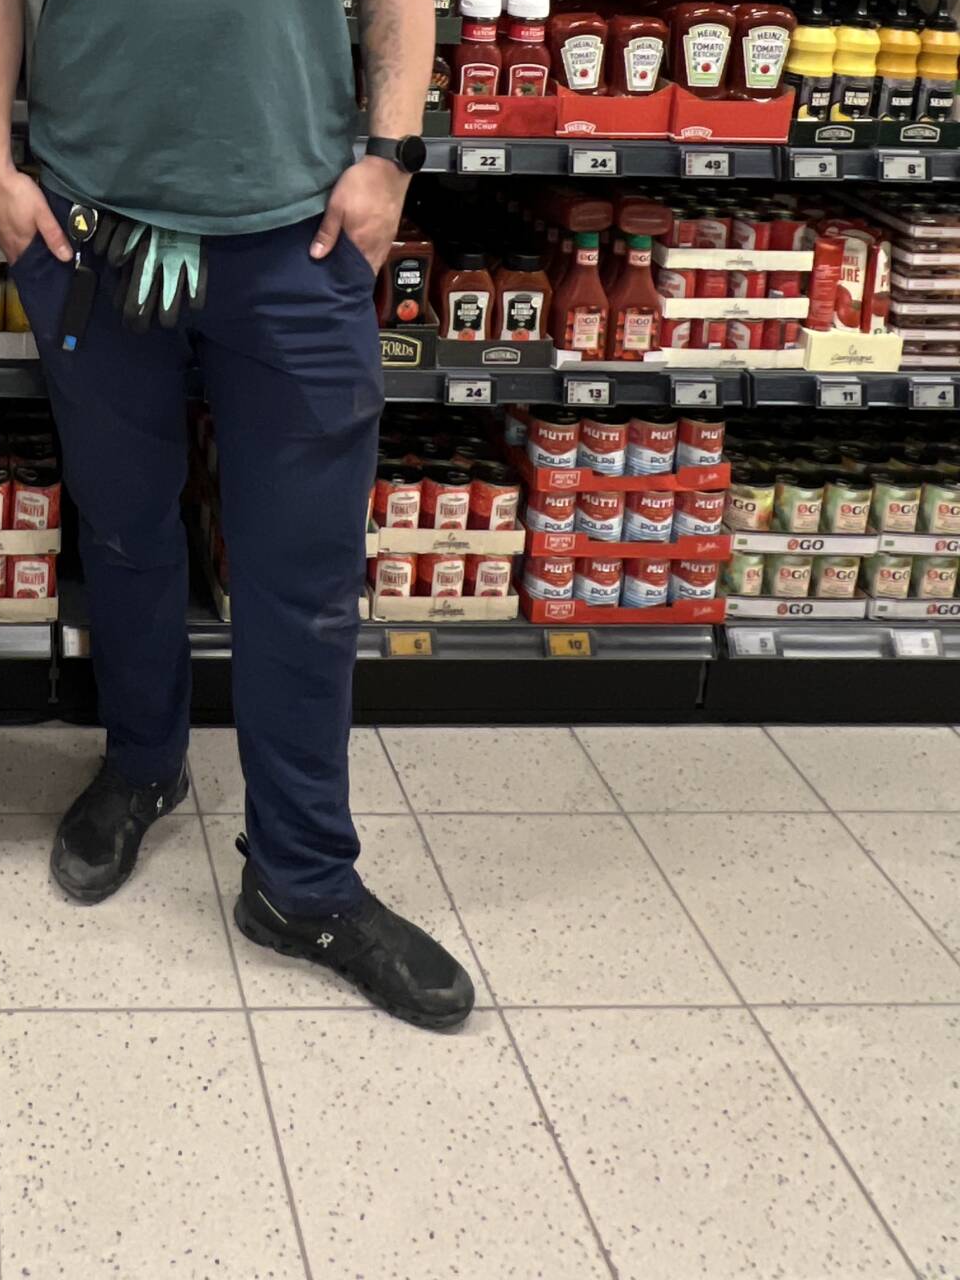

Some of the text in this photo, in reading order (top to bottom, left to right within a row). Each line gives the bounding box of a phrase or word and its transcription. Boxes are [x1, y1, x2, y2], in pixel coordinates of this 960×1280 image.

[697, 29, 722, 39] HEINZ
[756, 31, 782, 41] HEINZ
[692, 42, 723, 51] TOMATO
[751, 44, 784, 54] TOMATO
[692, 50, 722, 58] KETCHUP
[752, 52, 782, 61] KETCHUP
[464, 122, 498, 130] KETCHUP
[568, 123, 593, 132] HEINZ
[479, 156, 497, 167] 22
[590, 158, 608, 169] 24
[818, 162, 828, 173] 9
[628, 317, 650, 326] ØGO
[382, 341, 415, 357] FORDS
[465, 388, 483, 398] 24
[588, 388, 602, 399] 13
[698, 389, 708, 400] 4
[842, 391, 854, 401] 11
[937, 391, 947, 401] 4
[538, 427, 575, 441] MUTTI
[583, 427, 620, 442] MUTTI
[538, 453, 571, 464] POLPA
[581, 451, 616, 465] POLPA
[581, 494, 618, 508] MUTTI
[15, 502, 44, 518] TOMATER
[391, 501, 418, 515] TOMATER
[580, 517, 614, 531] POLPA
[787, 539, 824, 552] ØGO
[680, 561, 715, 573] MUTTI
[16, 571, 45, 585] TOMATER
[380, 570, 408, 585] TOMATER
[437, 572, 464, 587] TOMATER
[480, 571, 509, 585] TOMATER
[779, 568, 809, 580] ØGO
[824, 567, 856, 581] ØGO
[879, 569, 908, 581] ØGO
[926, 569, 955, 581] ØGO
[679, 585, 711, 597] POLPA
[776, 603, 814, 616] ØGO
[759, 637, 768, 648] 5
